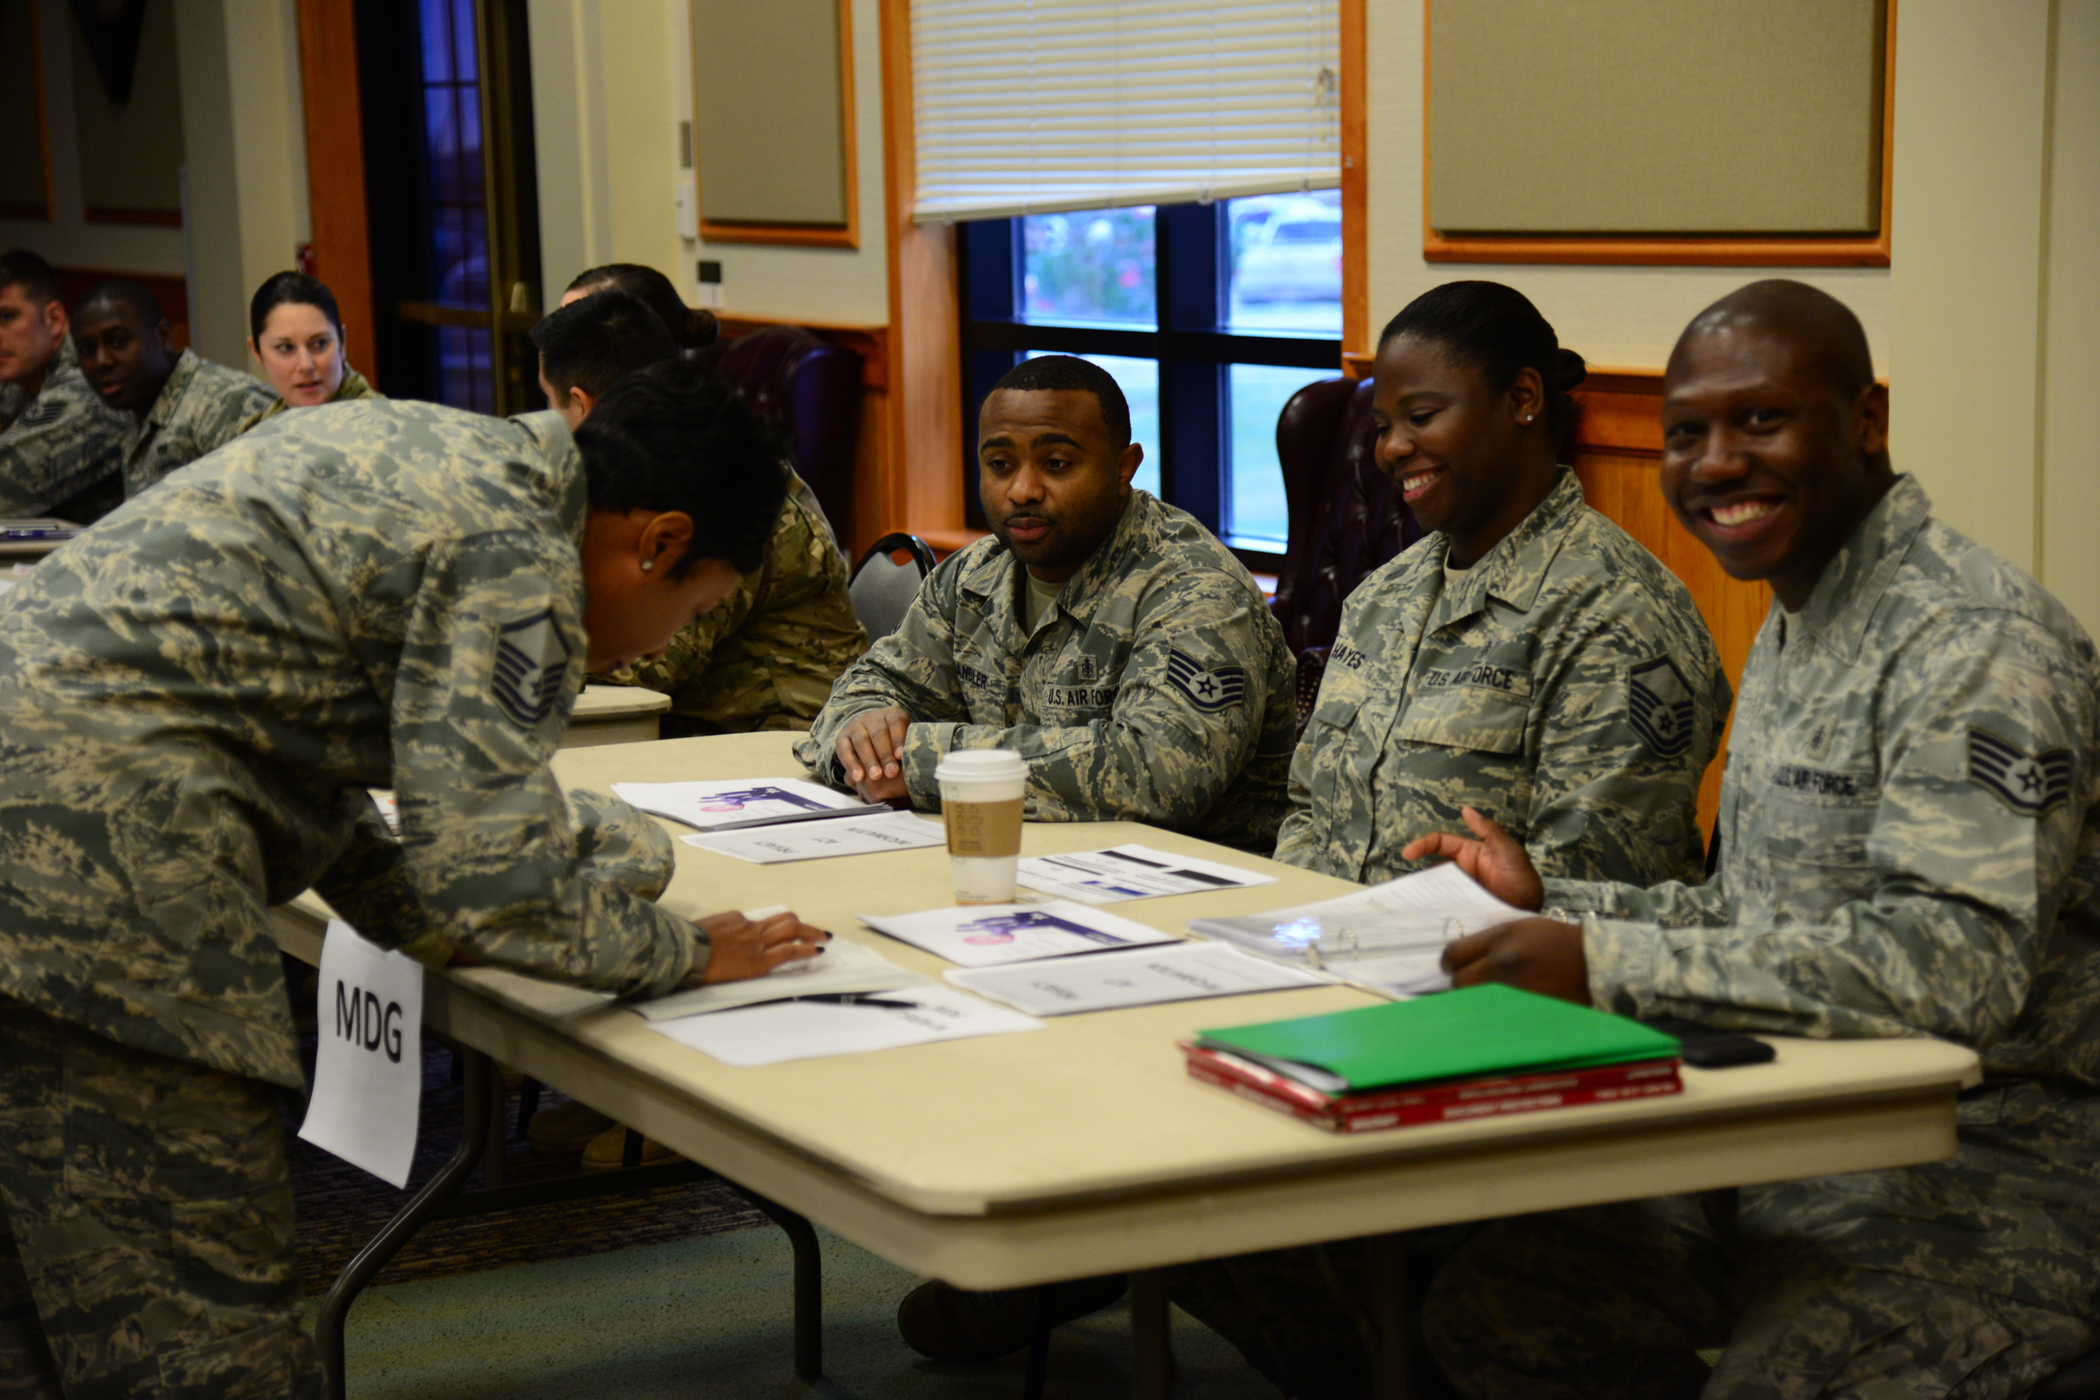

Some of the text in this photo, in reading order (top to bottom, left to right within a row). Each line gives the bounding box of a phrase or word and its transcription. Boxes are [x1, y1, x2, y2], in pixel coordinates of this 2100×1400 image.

[1331, 642, 1366, 670] HAYES
[1471, 665, 1516, 690] ORCE
[1048, 688, 1065, 706] U.S.
[1067, 689, 1089, 706] AIR
[336, 979, 402, 1064] MDG
